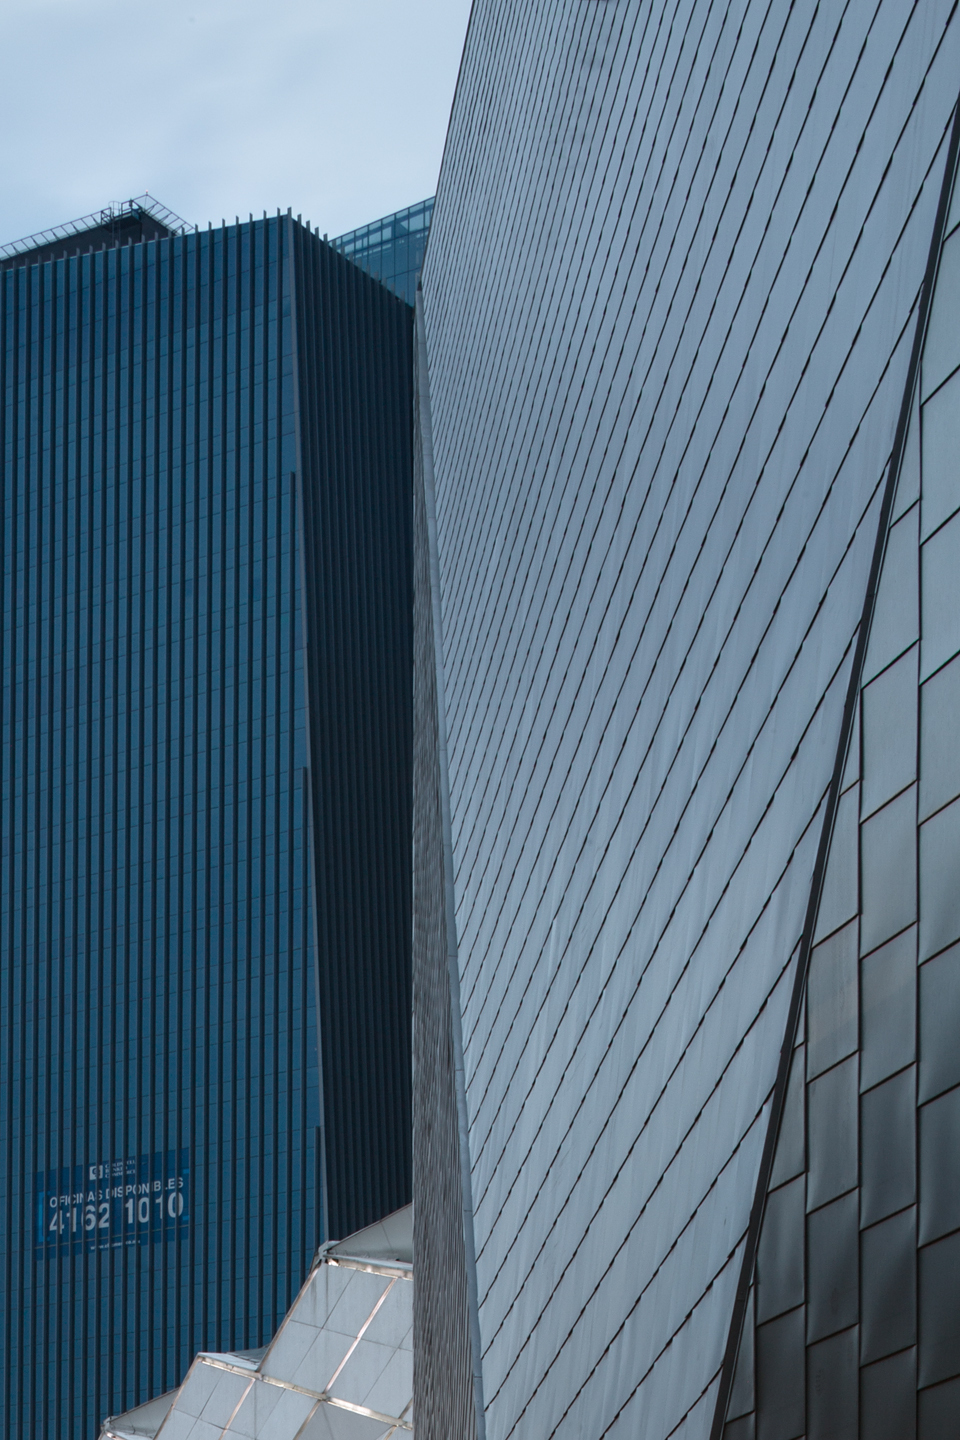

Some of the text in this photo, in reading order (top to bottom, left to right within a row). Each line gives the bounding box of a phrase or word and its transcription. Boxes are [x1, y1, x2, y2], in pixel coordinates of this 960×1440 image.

[105, 1177, 184, 1199] DISPONIBES
[49, 1191, 184, 1234] 4162 1010
